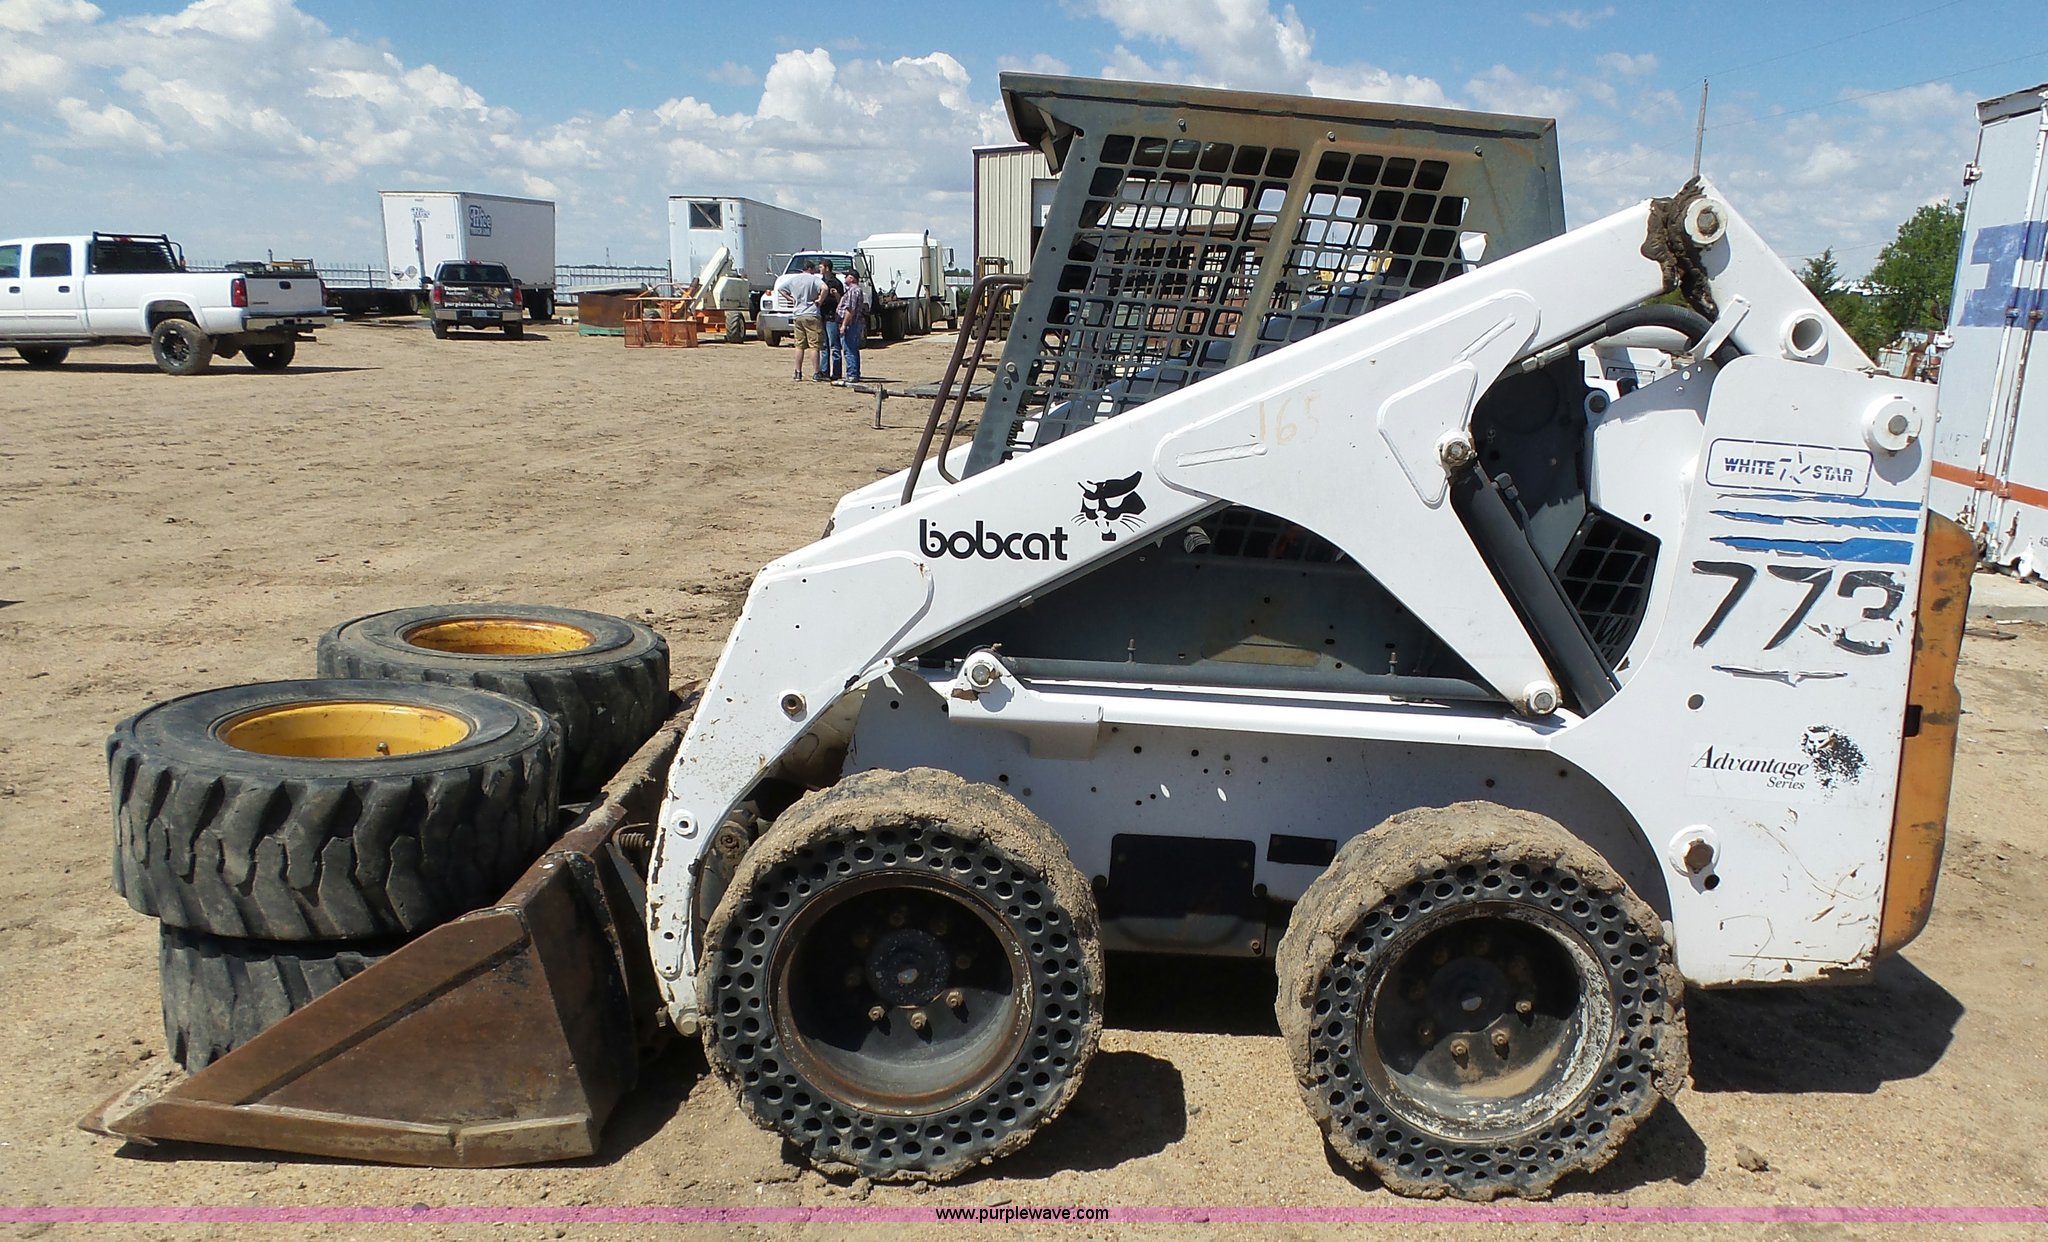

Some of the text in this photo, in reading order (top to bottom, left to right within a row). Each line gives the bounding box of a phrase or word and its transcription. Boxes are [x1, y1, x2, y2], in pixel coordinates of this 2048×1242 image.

[1724, 457, 1853, 482] WHITE STAR
[919, 518, 1068, 561] bobcat
[1692, 560, 1905, 656] 773
[1691, 744, 1810, 781] Advantage
[1766, 776, 1806, 791] Series
